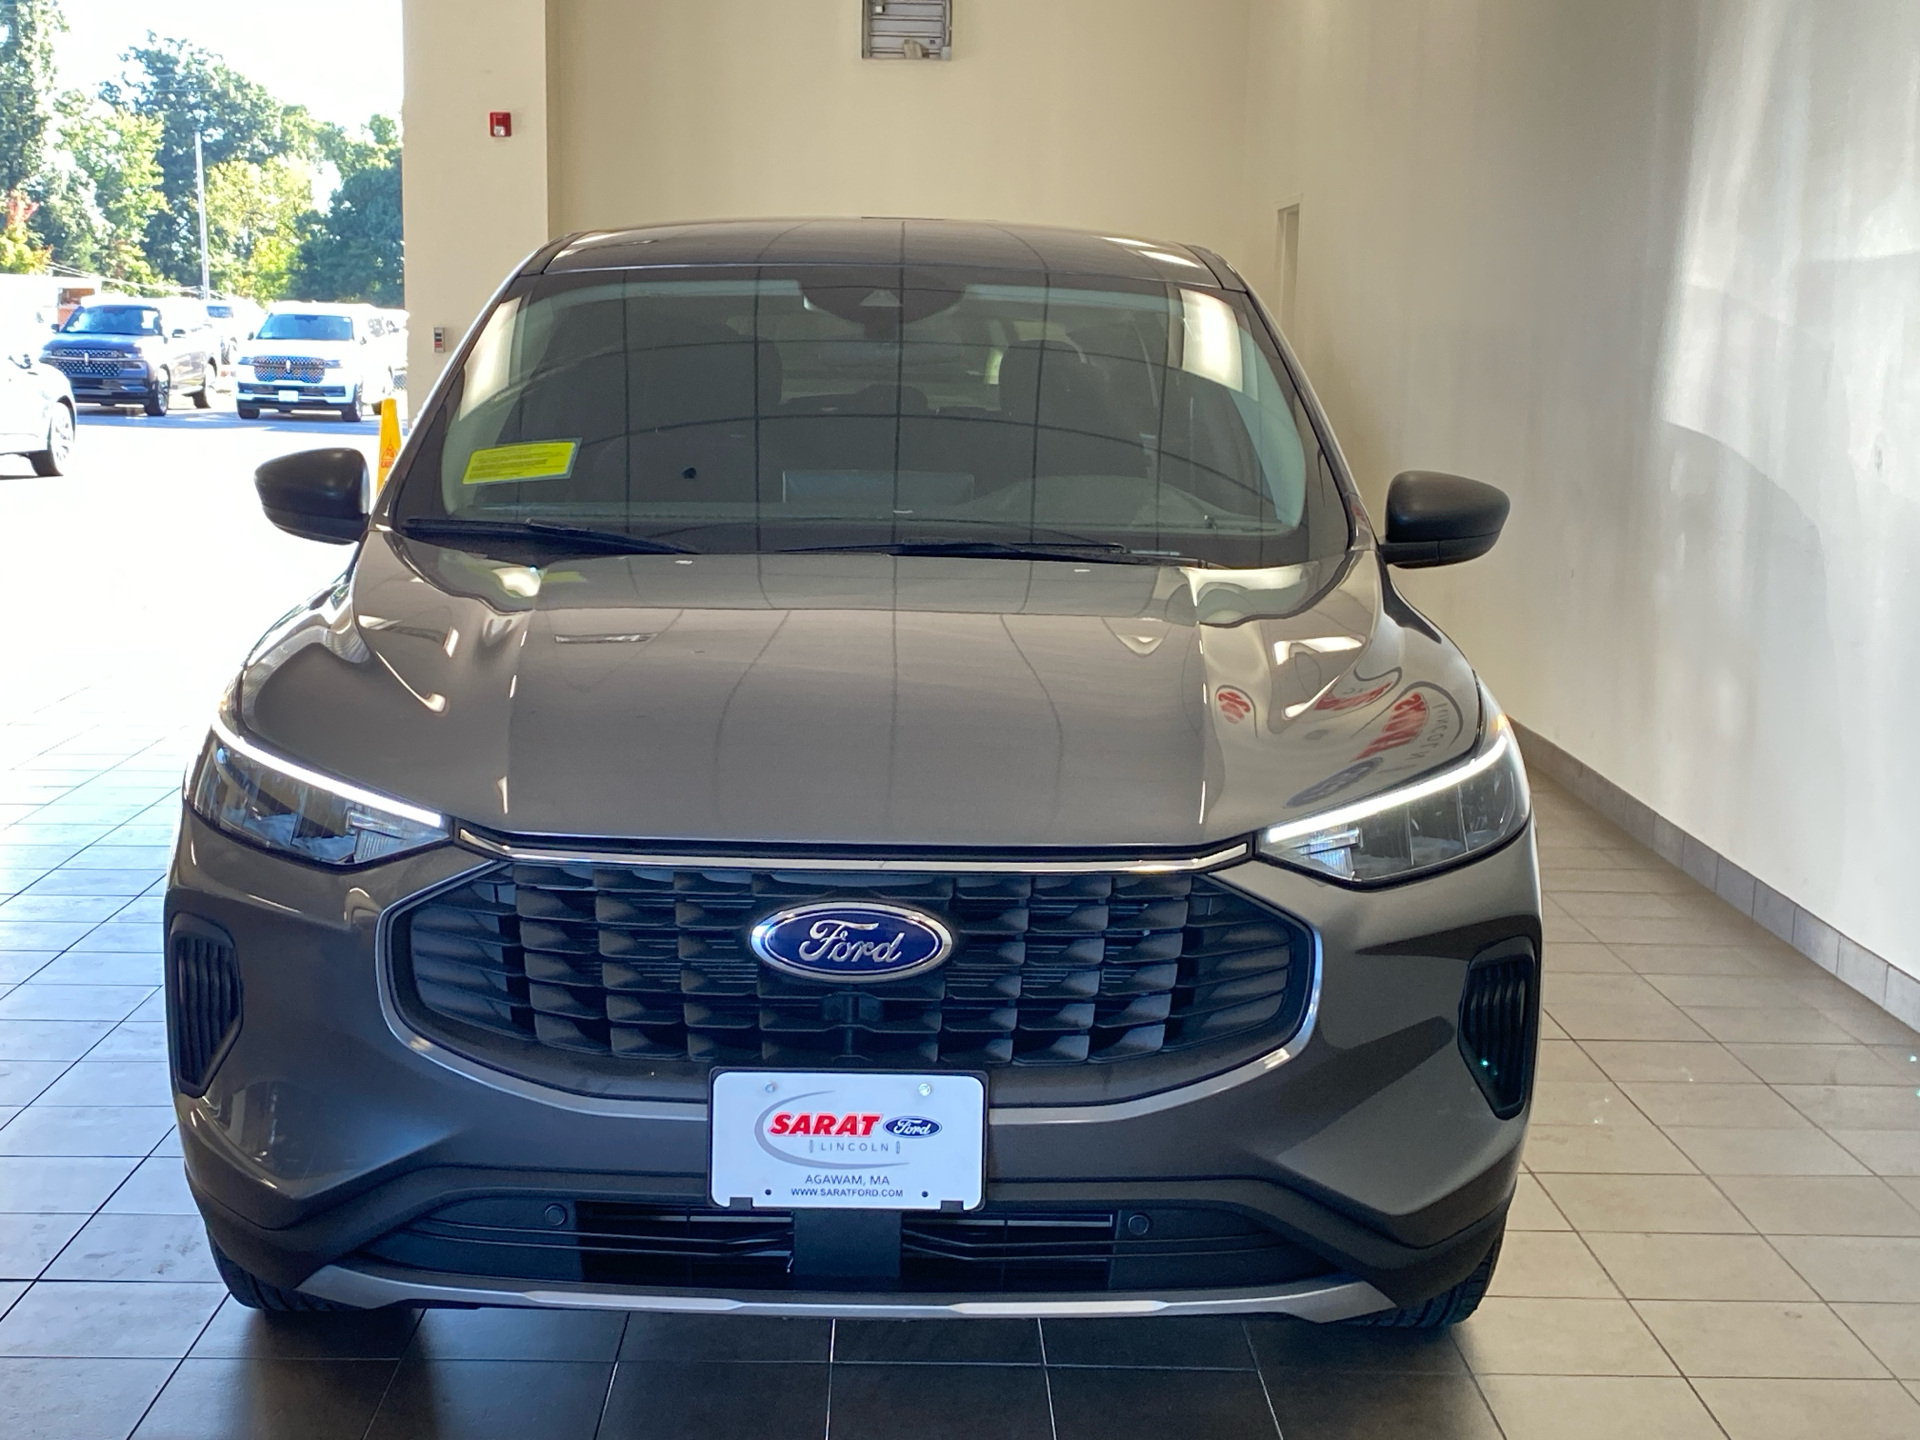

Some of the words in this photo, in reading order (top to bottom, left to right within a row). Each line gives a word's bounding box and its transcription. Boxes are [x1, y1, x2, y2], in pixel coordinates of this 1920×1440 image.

[798, 919, 905, 963] Ford
[769, 1112, 882, 1137] SARAT
[893, 1119, 931, 1136] Ford
[820, 1142, 889, 1152] LINCOLN
[805, 1174, 867, 1186] AGAWAM,
[870, 1175, 890, 1185] MA
[791, 1188, 904, 1198] WWW.SARATFORD.COM
